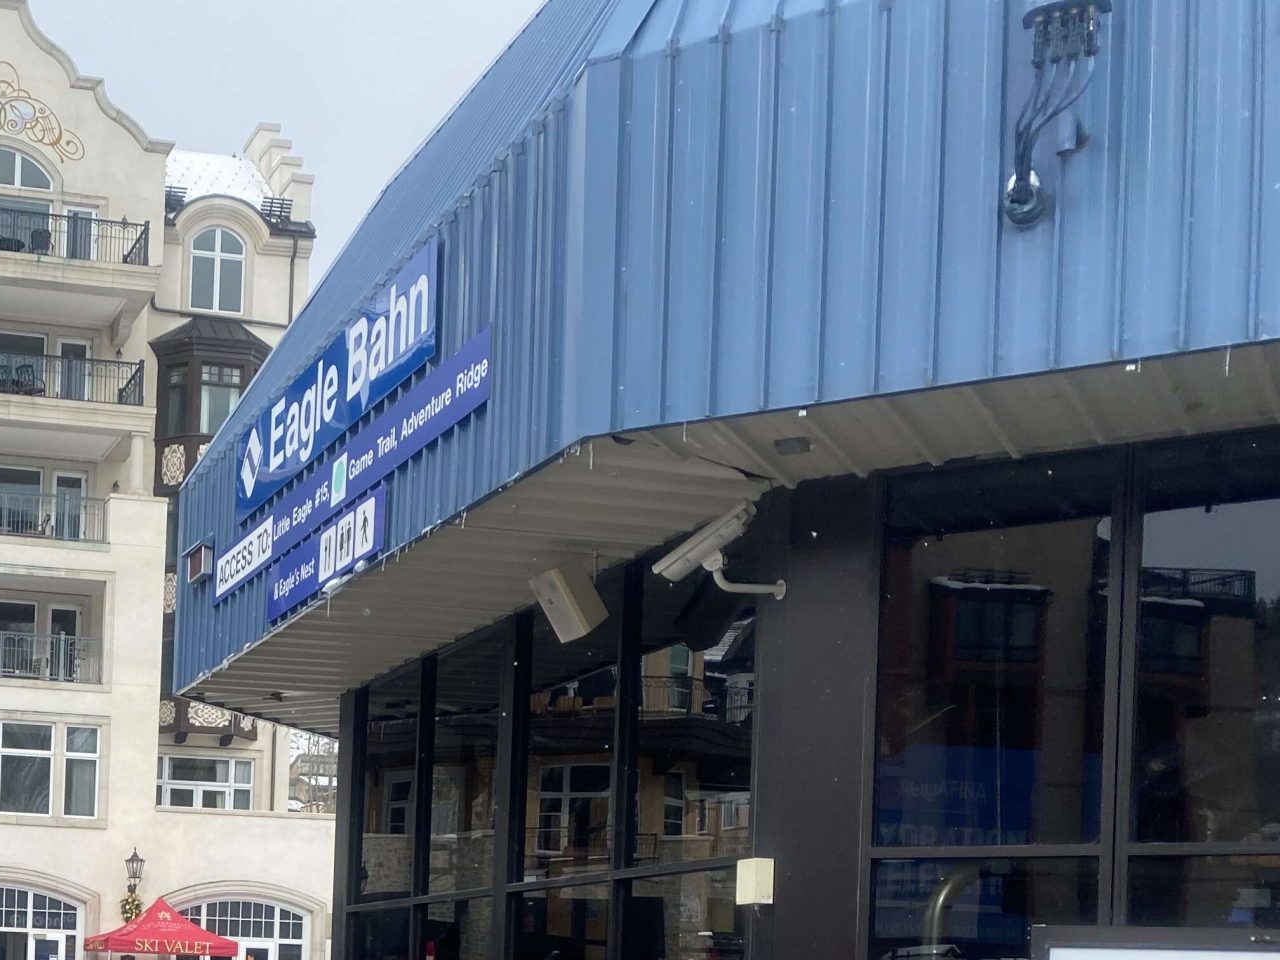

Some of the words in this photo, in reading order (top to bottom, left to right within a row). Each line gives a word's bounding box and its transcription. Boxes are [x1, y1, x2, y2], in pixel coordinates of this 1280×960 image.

[269, 359, 338, 474] Eagle
[346, 273, 430, 402] Bahn
[217, 540, 253, 589] ACCESS
[257, 528, 271, 558] TO:
[273, 515, 291, 541] Little
[292, 498, 312, 527] Eagle
[348, 449, 374, 481] Game
[377, 427, 398, 458] Trail,
[401, 388, 452, 441] Adventure
[456, 358, 489, 398] Ridge
[273, 582, 279, 600] &
[279, 568, 300, 596] Eagle's
[301, 557, 315, 579] Nest
[135, 938, 159, 951] SKI
[164, 940, 213, 954] VALET
